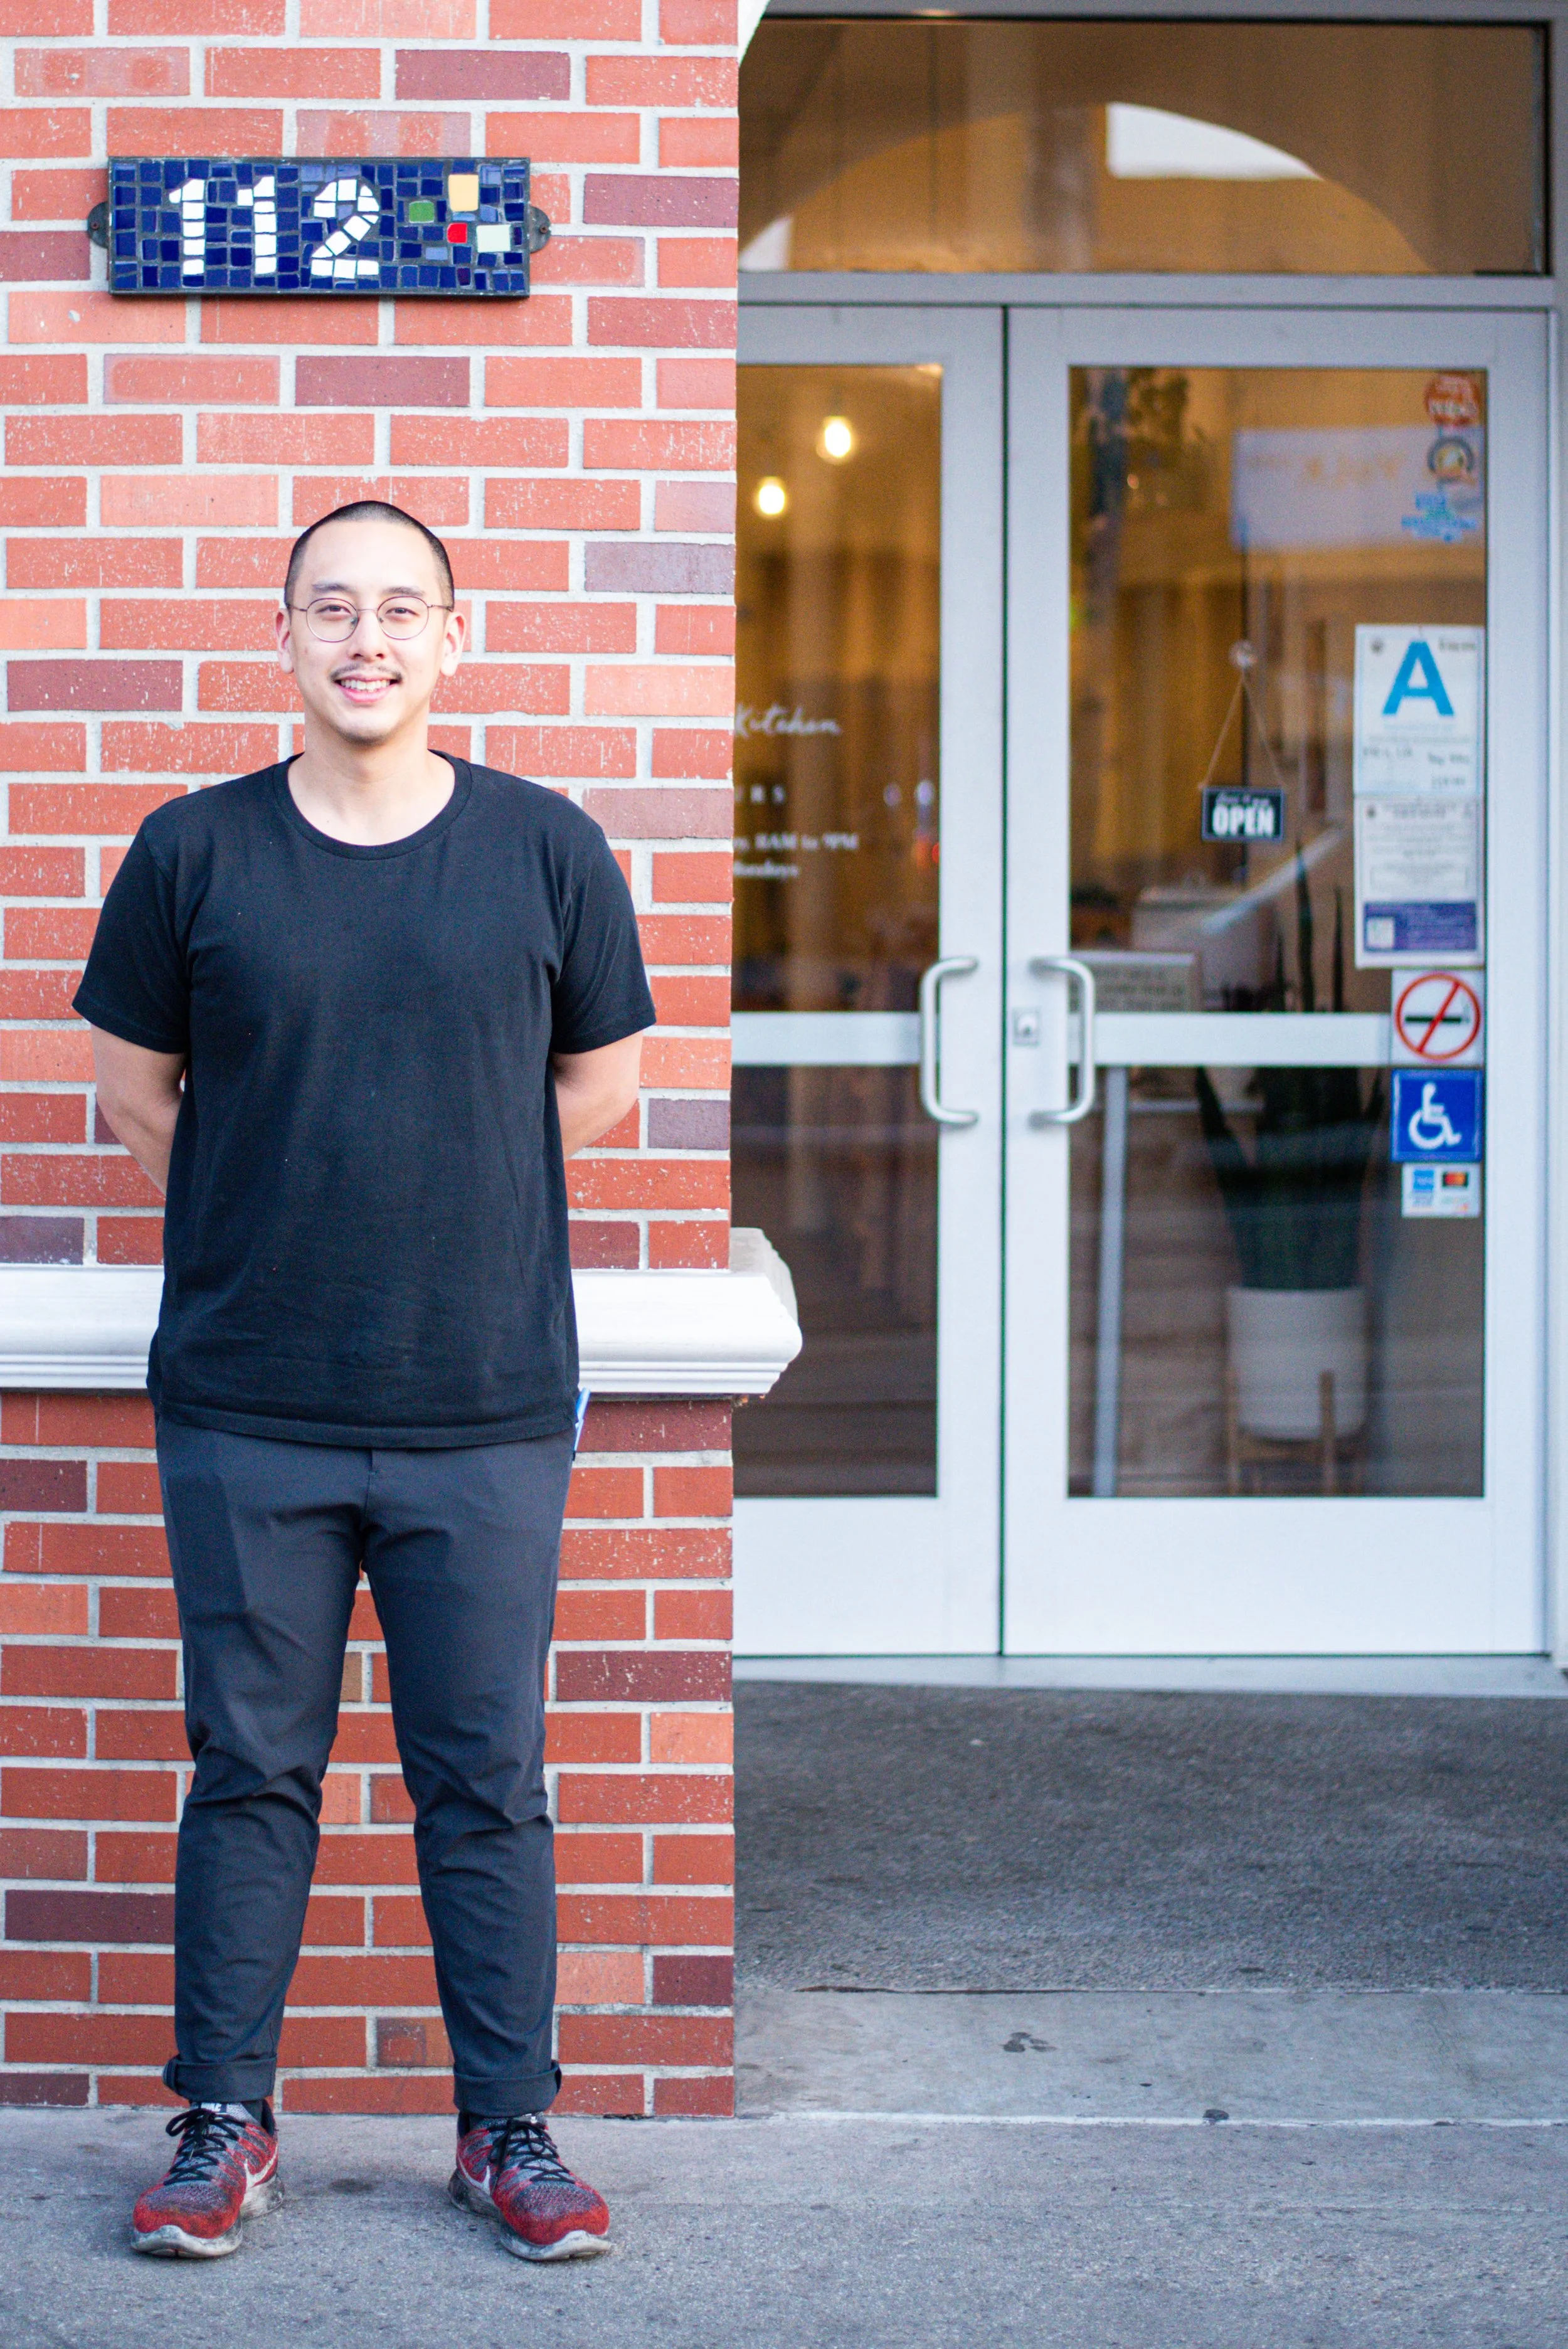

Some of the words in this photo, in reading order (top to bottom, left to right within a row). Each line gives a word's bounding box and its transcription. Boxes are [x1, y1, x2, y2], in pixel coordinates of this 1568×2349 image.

[169, 176, 379, 278] 112
[1382, 641, 1455, 716] A
[1212, 805, 1274, 836] OPEN
